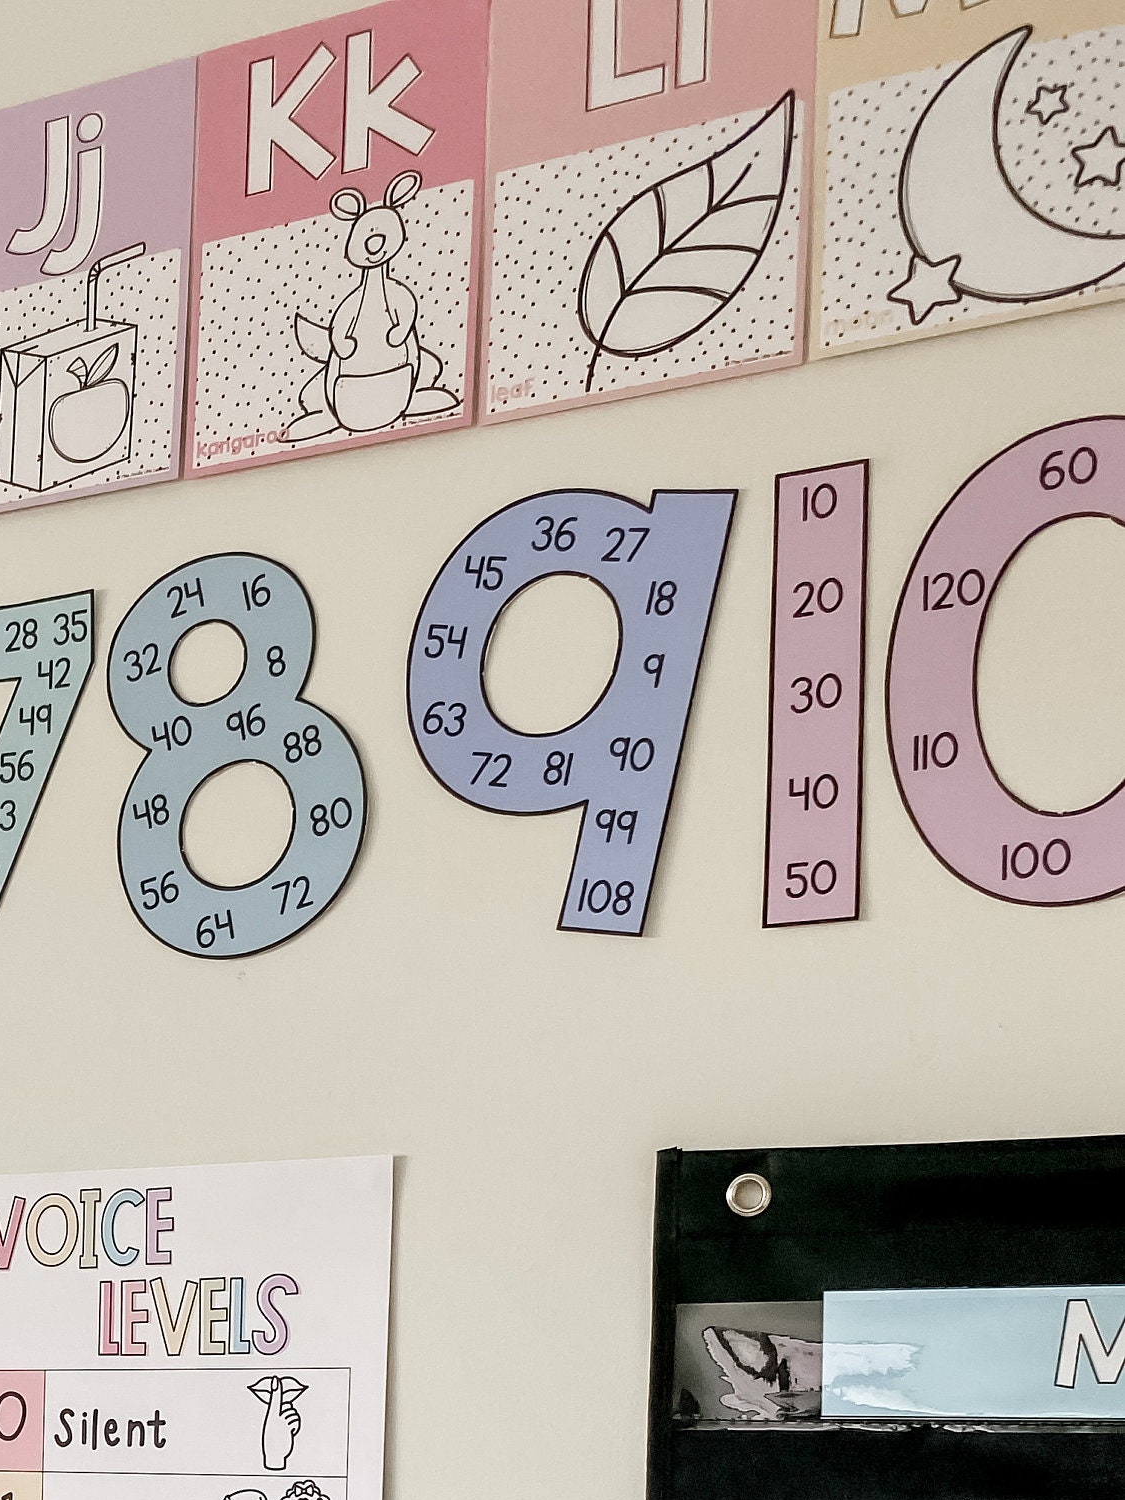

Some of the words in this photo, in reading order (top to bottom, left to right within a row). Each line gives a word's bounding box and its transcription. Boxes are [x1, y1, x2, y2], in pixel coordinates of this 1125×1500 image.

[246, 29, 436, 198] Kk
[6, 112, 103, 275] Jj
[197, 428, 290, 458] kangaroo
[1039, 446, 1097, 490] 60
[803, 483, 837, 522] 10
[601, 528, 650, 562] 27
[465, 556, 507, 591] 45
[923, 568, 985, 611] 120
[167, 578, 204, 617] 24
[6, 619, 37, 652] 28
[53, 611, 87, 645] 35
[267, 646, 285, 677] 8
[644, 654, 665, 688] 9
[406, 488, 739, 937] 9
[791, 673, 842, 714] 30
[20, 704, 51, 735] 49
[152, 716, 192, 751] 40
[423, 702, 467, 736] 63
[107, 552, 368, 960] 8
[283, 725, 322, 763] 88
[913, 732, 958, 771] 110
[543, 751, 574, 786] 81
[140, 871, 179, 910] 56
[272, 876, 313, 915] 72
[578, 878, 635, 915] 108
[785, 860, 837, 898] 50
[98, 1274, 300, 1357] LEVELS
[53, 1408, 168, 1451] Silent
